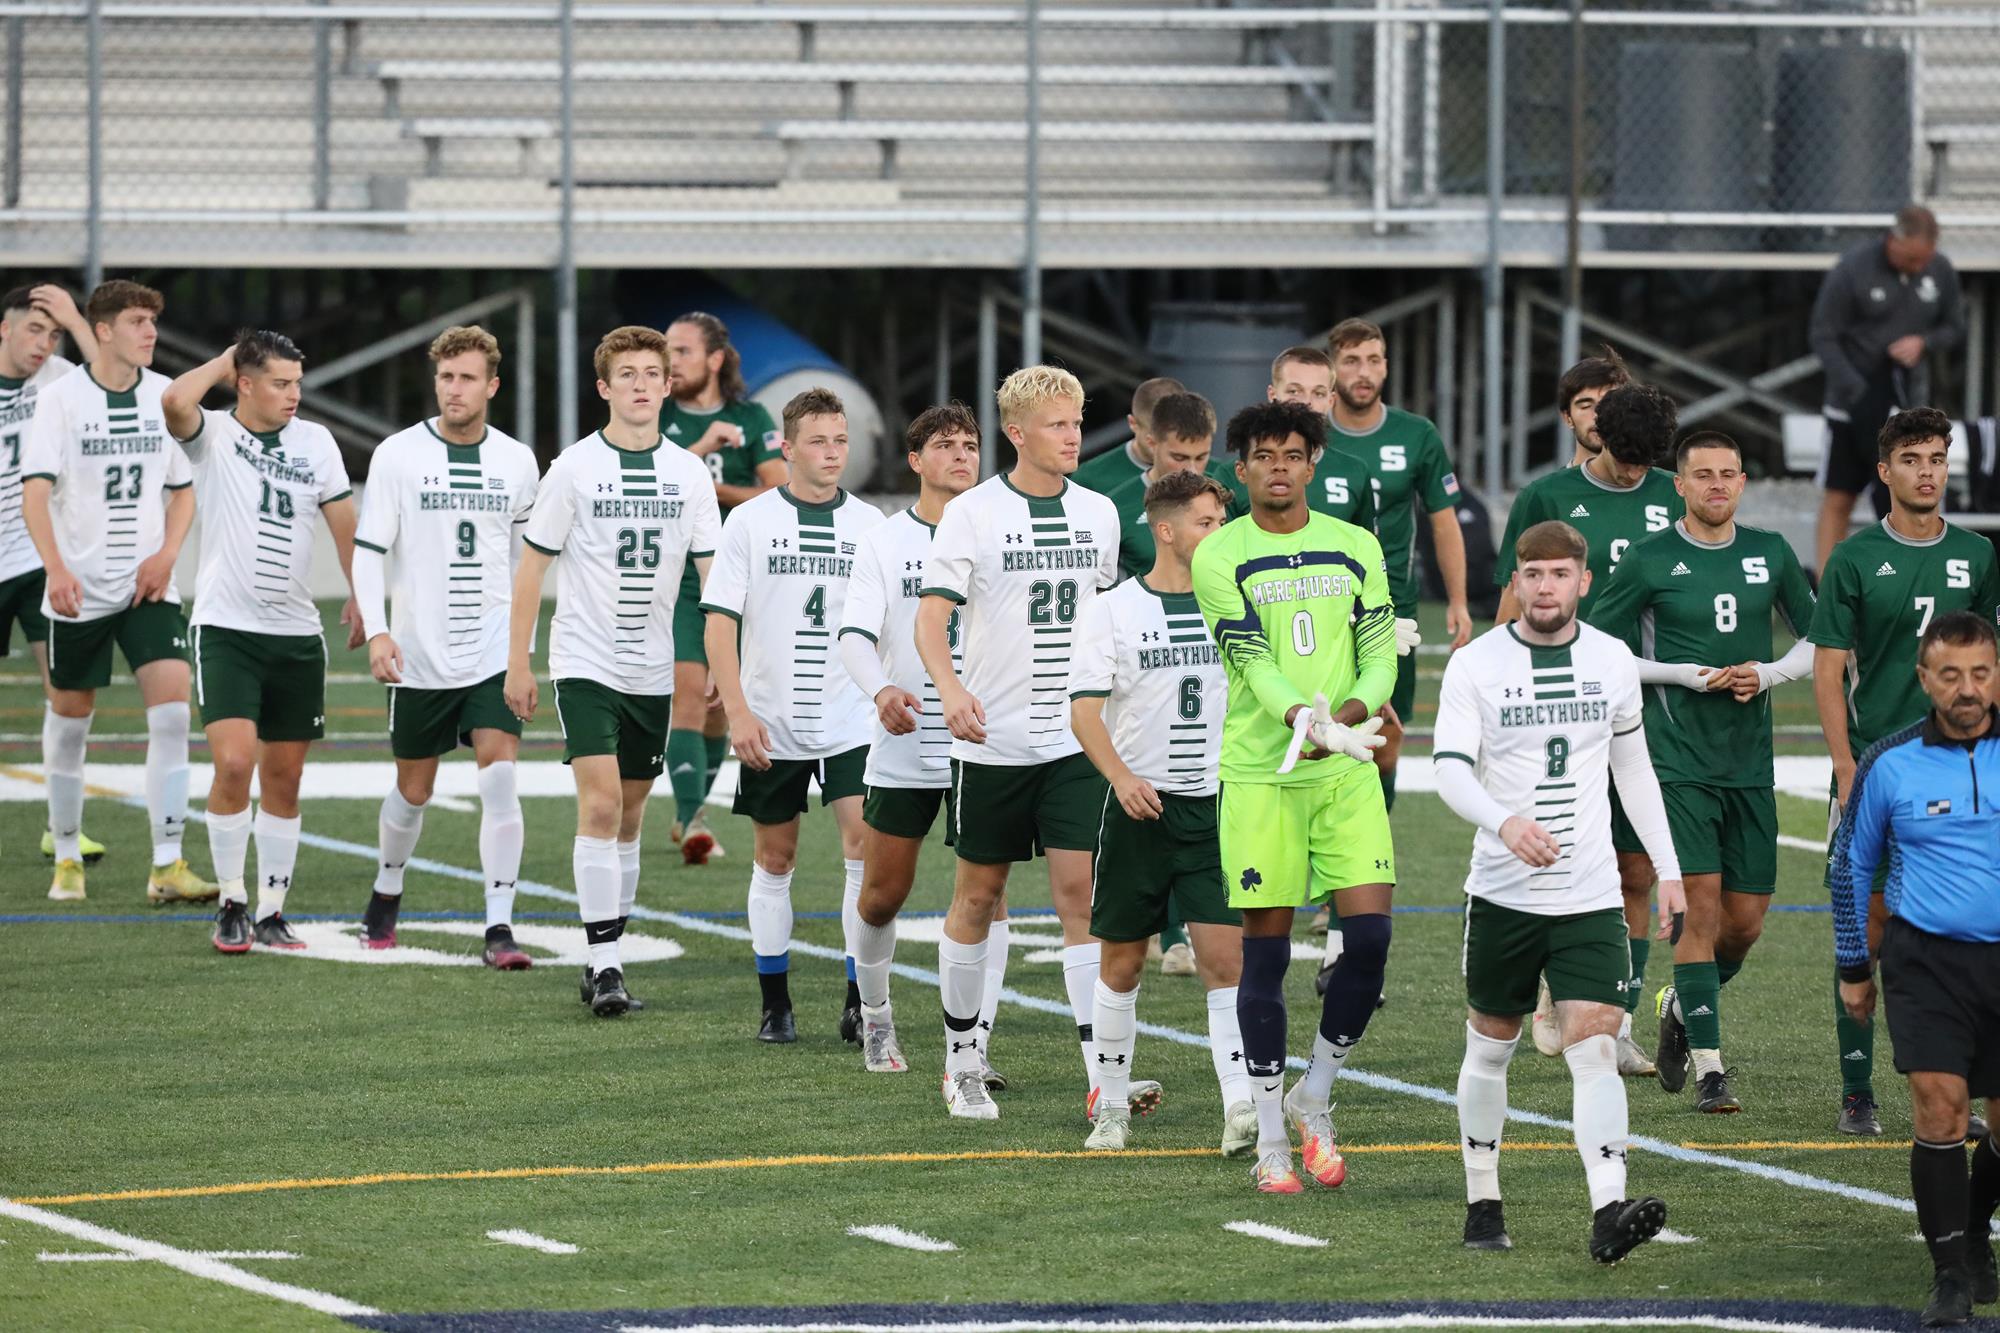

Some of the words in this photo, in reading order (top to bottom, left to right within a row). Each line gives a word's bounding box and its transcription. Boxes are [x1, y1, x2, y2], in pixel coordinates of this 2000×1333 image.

[81, 435, 163, 456] MERCYHURST
[1380, 445, 1407, 471] S
[104, 463, 143, 501] 23
[1324, 476, 1349, 504] S
[420, 491, 510, 513] MERCYHURST
[592, 499, 684, 520] MERCYHURST
[1645, 504, 1670, 532] S
[456, 519, 477, 560] 9
[615, 526, 663, 570] 25
[1002, 547, 1099, 572] MERCYHURST
[1741, 556, 1770, 584] S
[1946, 559, 1971, 588] S
[803, 584, 826, 628] 4
[1028, 579, 1079, 625] 28
[1713, 593, 1738, 632] 8
[1914, 596, 1935, 637] 7
[1292, 609, 1316, 656] 0
[1178, 675, 1202, 721] 6
[1499, 699, 1608, 728] MERCYHURST
[1544, 734, 1572, 780] 8
